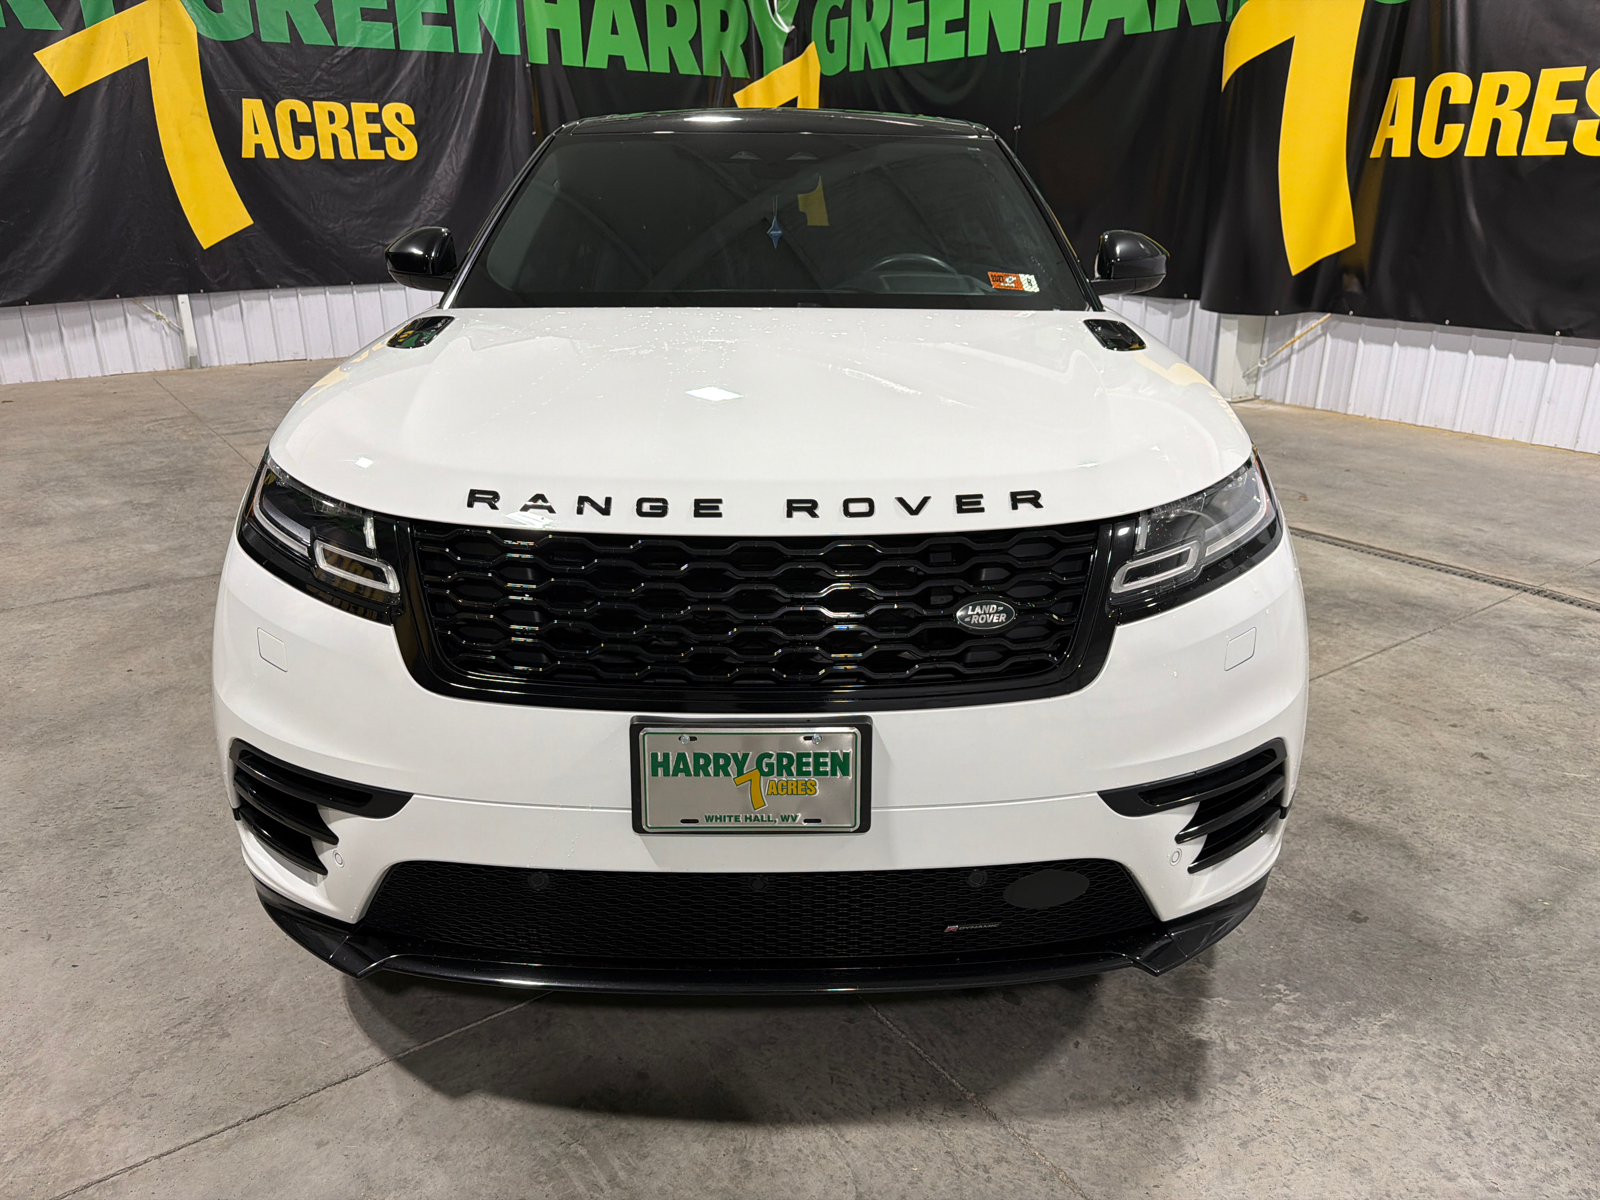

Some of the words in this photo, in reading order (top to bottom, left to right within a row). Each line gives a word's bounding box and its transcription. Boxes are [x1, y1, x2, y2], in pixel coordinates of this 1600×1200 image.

[811, 0, 1022, 76] GREEN
[242, 98, 418, 161] ACRES
[467, 488, 723, 518] RANGE
[786, 489, 1044, 519] ROVER
[968, 604, 997, 615] LAND
[971, 613, 1007, 624] ROVER
[650, 752, 750, 778] HARRY
[755, 752, 850, 778] GREEN
[733, 769, 766, 810] 7
[767, 780, 817, 796] ACRES
[704, 814, 741, 823] WHITE
[744, 814, 777, 824] HALL,
[780, 814, 799, 823] WV
